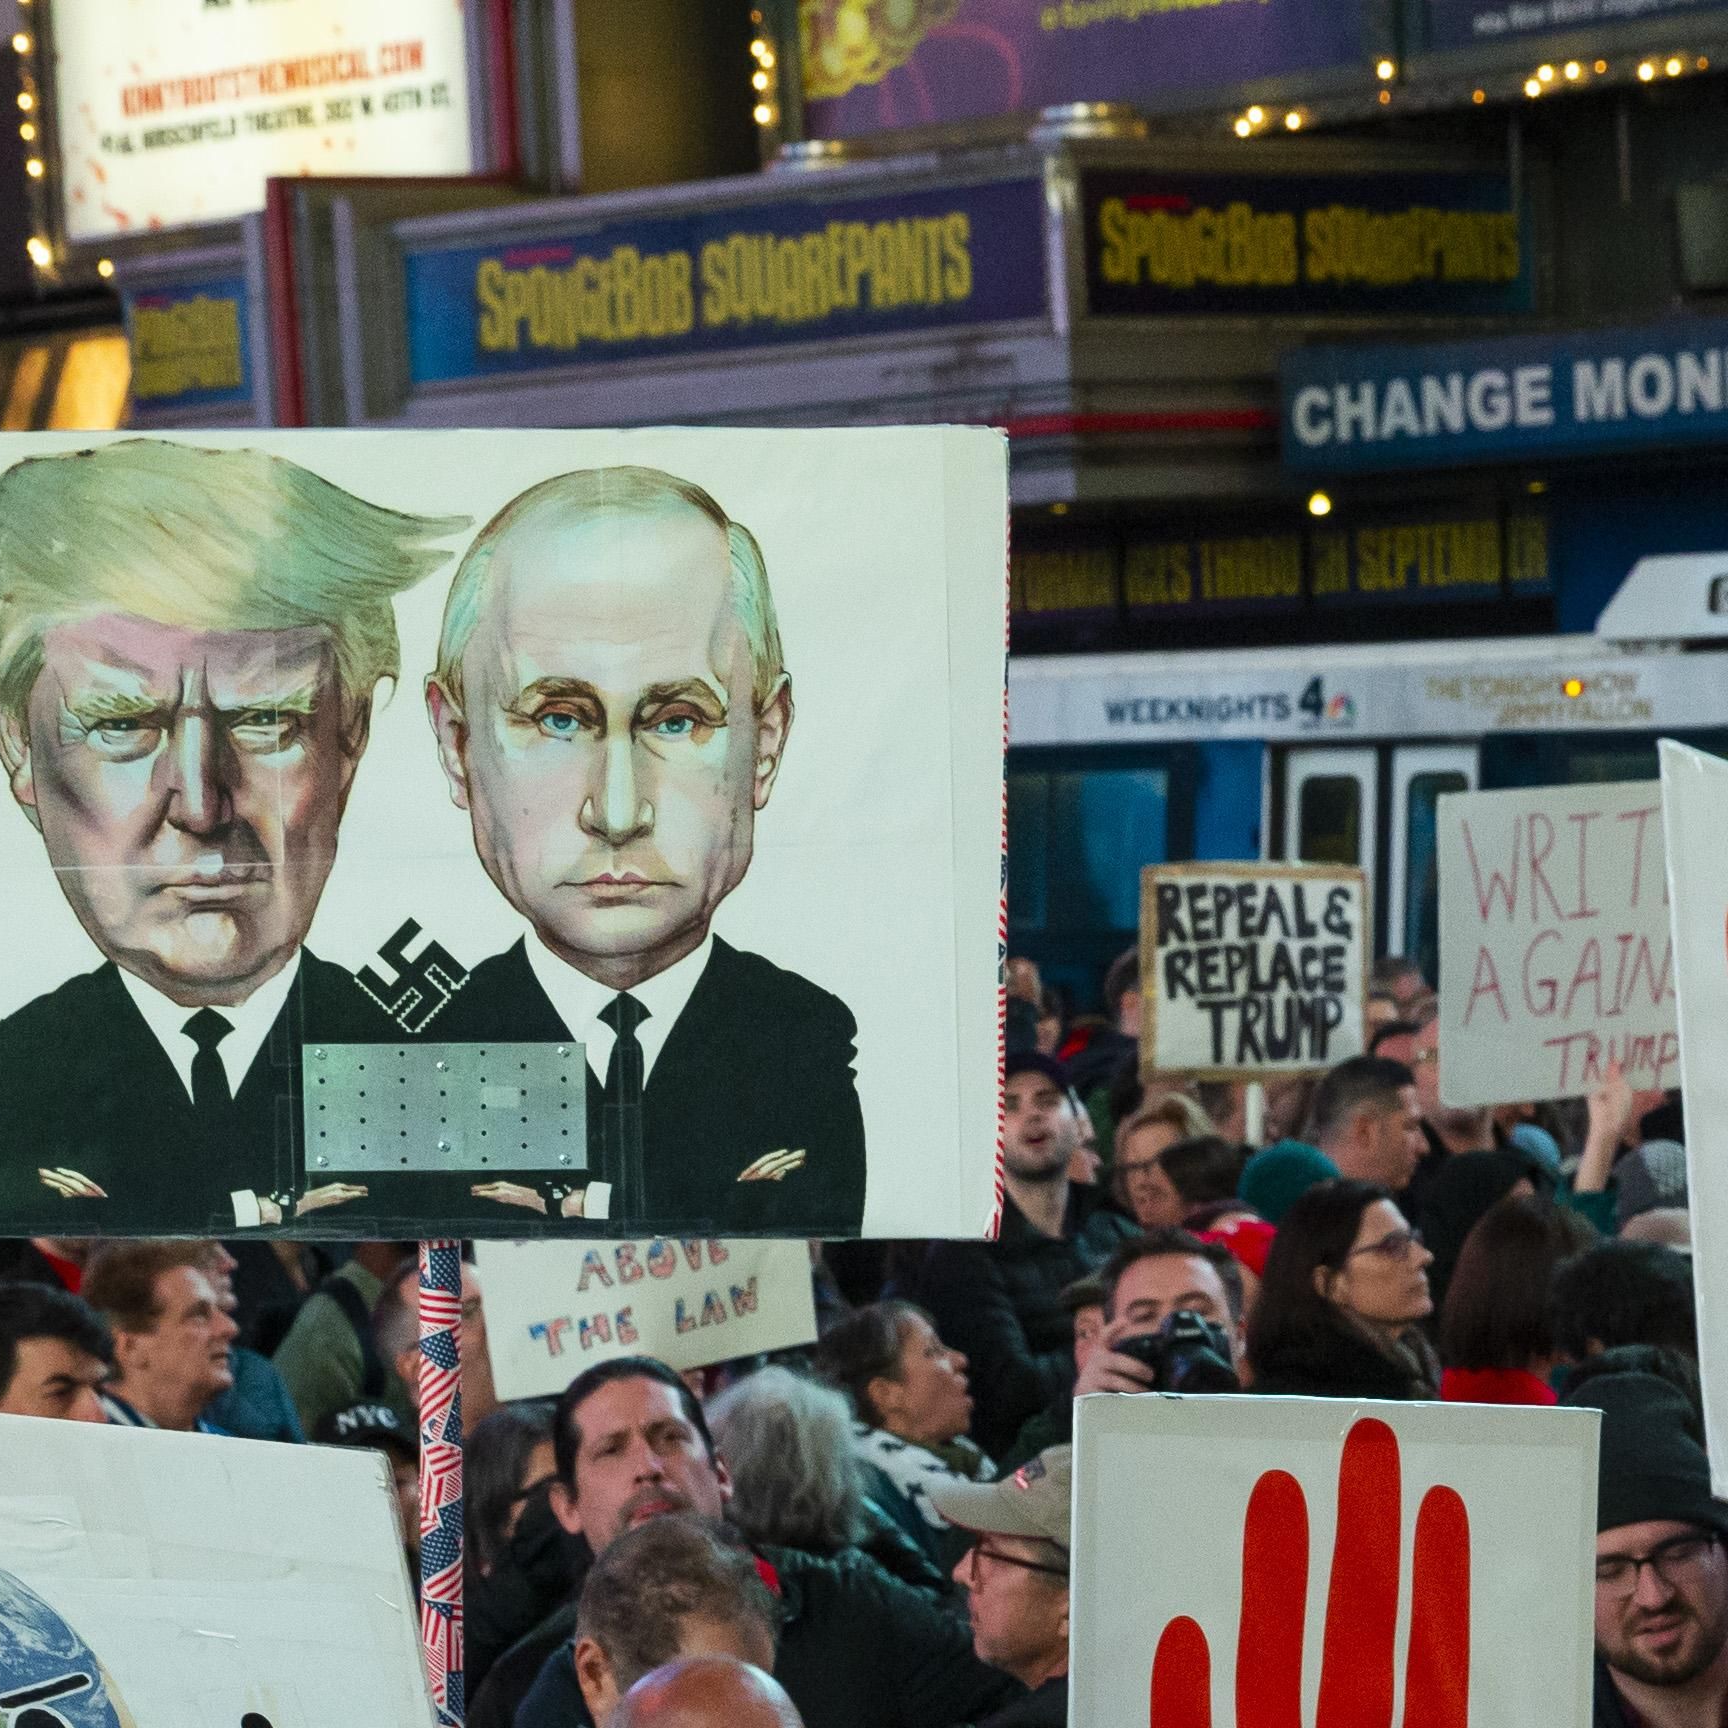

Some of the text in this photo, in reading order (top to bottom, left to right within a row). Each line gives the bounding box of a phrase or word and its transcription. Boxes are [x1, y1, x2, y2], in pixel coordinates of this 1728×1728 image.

[699, 211, 973, 328] SQUAREPANTS
[1291, 364, 1556, 448] CHANGE
[1104, 675, 1324, 726] WEEKNIGHTS 4
[1461, 804, 1670, 923] WRIT
[1156, 883, 1318, 947] REPEAL
[1165, 943, 1347, 1001] REPLACE
[1463, 929, 1675, 1027] AGAIN
[1196, 997, 1344, 1064] TRUMP
[577, 1239, 730, 1292] ABOVE
[528, 1276, 760, 1358] THE LAW
